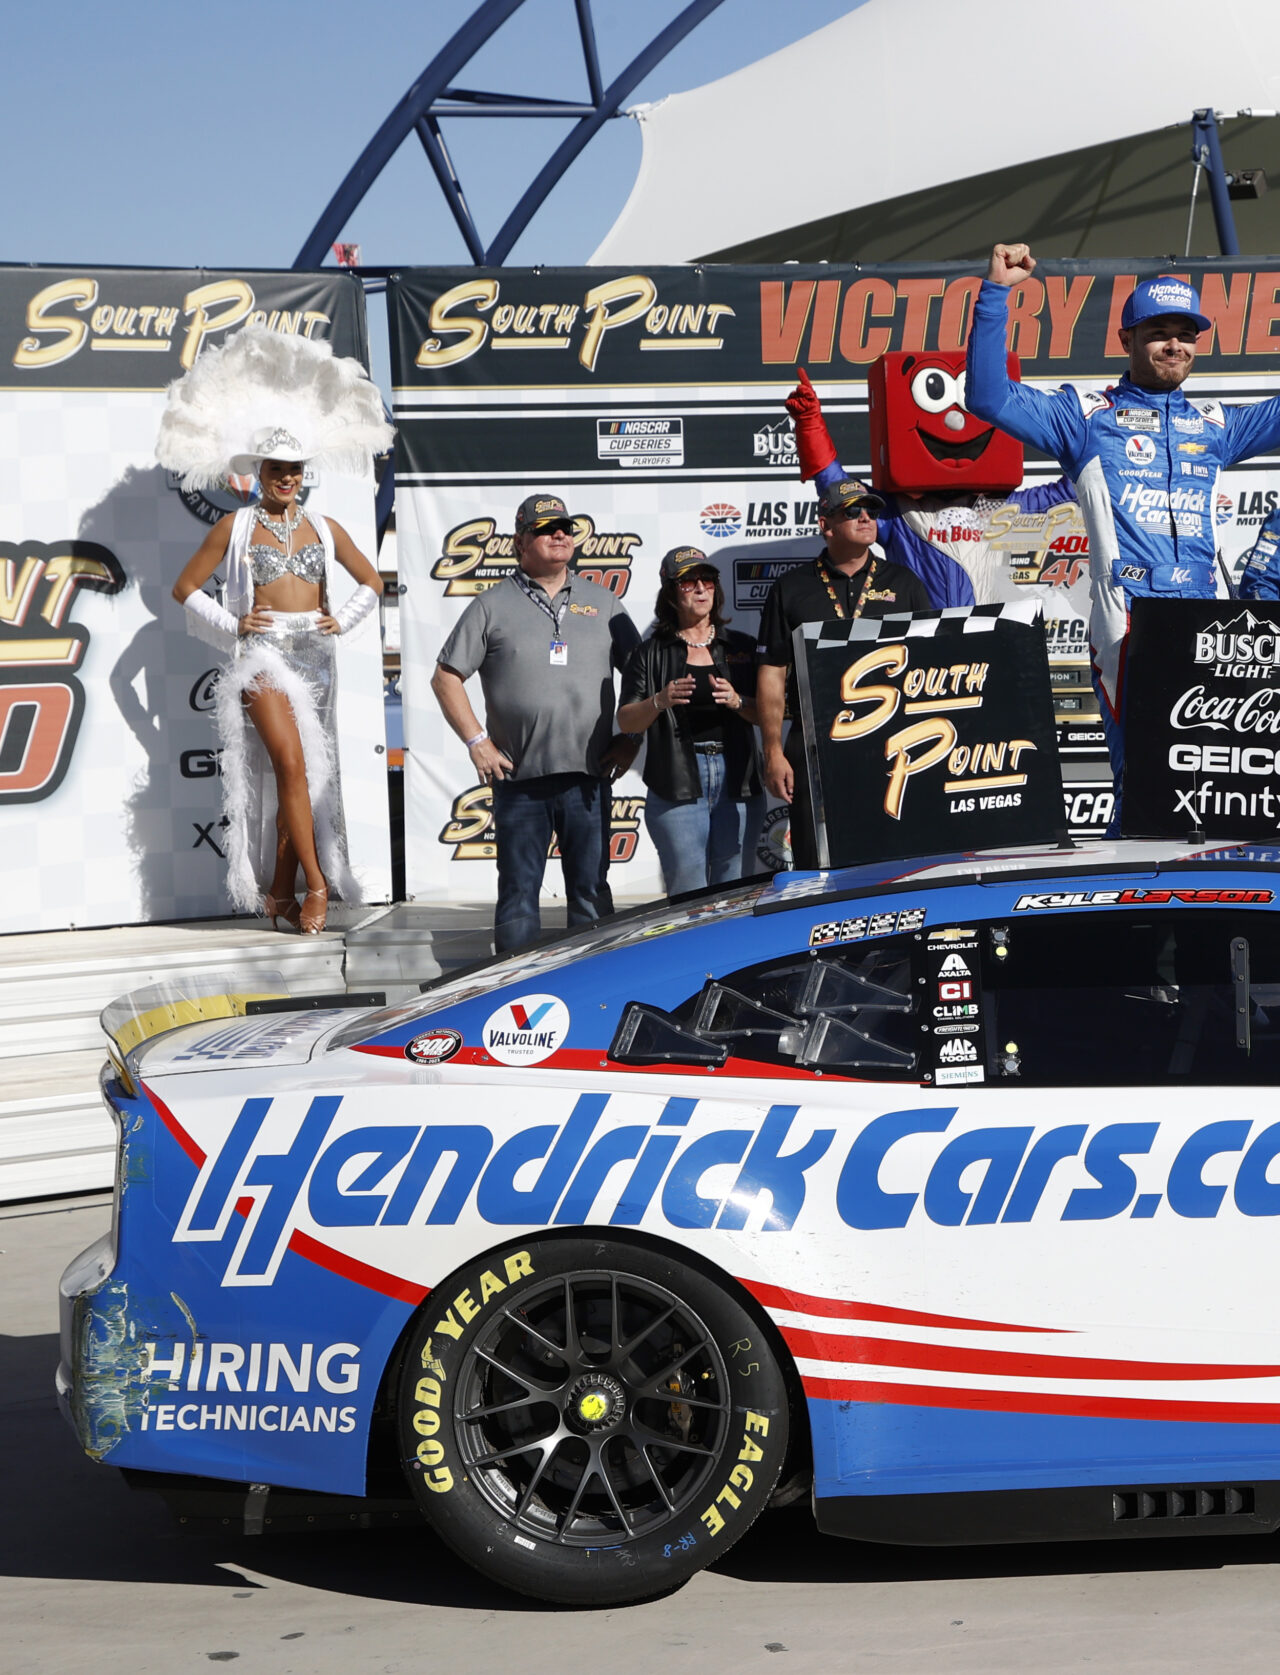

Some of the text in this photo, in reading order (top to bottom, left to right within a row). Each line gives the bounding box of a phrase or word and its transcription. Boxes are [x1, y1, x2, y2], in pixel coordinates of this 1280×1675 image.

[415, 275, 736, 372] SOUTH POINT
[760, 275, 1096, 364] VICTORY
[624, 421, 671, 434] NASCAR
[609, 439, 672, 450] CUP SERIES
[753, 432, 798, 458] BUS
[632, 456, 671, 466] PLAYOFFS
[765, 453, 800, 465] LIGH
[1118, 468, 1162, 478] GOODYEAR
[1119, 483, 1206, 513] Hendrick
[1237, 491, 1278, 515] LAS
[745, 502, 788, 526] LAS
[1135, 506, 1202, 526] Cars.com
[745, 528, 792, 538] MOTOR
[435, 518, 513, 578] SOU
[1119, 565, 1147, 582] K1
[1214, 664, 1267, 679] LIGHT
[830, 644, 990, 740] SOUTH
[1068, 732, 1106, 742] GEICO
[884, 717, 1038, 820] POINT
[950, 793, 1022, 814] LAS VEGAS
[1014, 891, 1121, 911] KYLE
[927, 942, 979, 951] CHEVROLET
[937, 969, 972, 978] AXALTA
[933, 1004, 979, 1018] CLIMB
[412, 1038, 453, 1054] 300
[489, 1029, 556, 1049] VALVOLINE
[940, 1038, 978, 1057] MAC
[939, 1054, 978, 1063] TOOLS
[941, 1071, 978, 1080] SIEMENS
[140, 1342, 361, 1394] HIRING
[140, 1404, 358, 1433] TECHNICIANS
[700, 1410, 770, 1537] EAGLE
